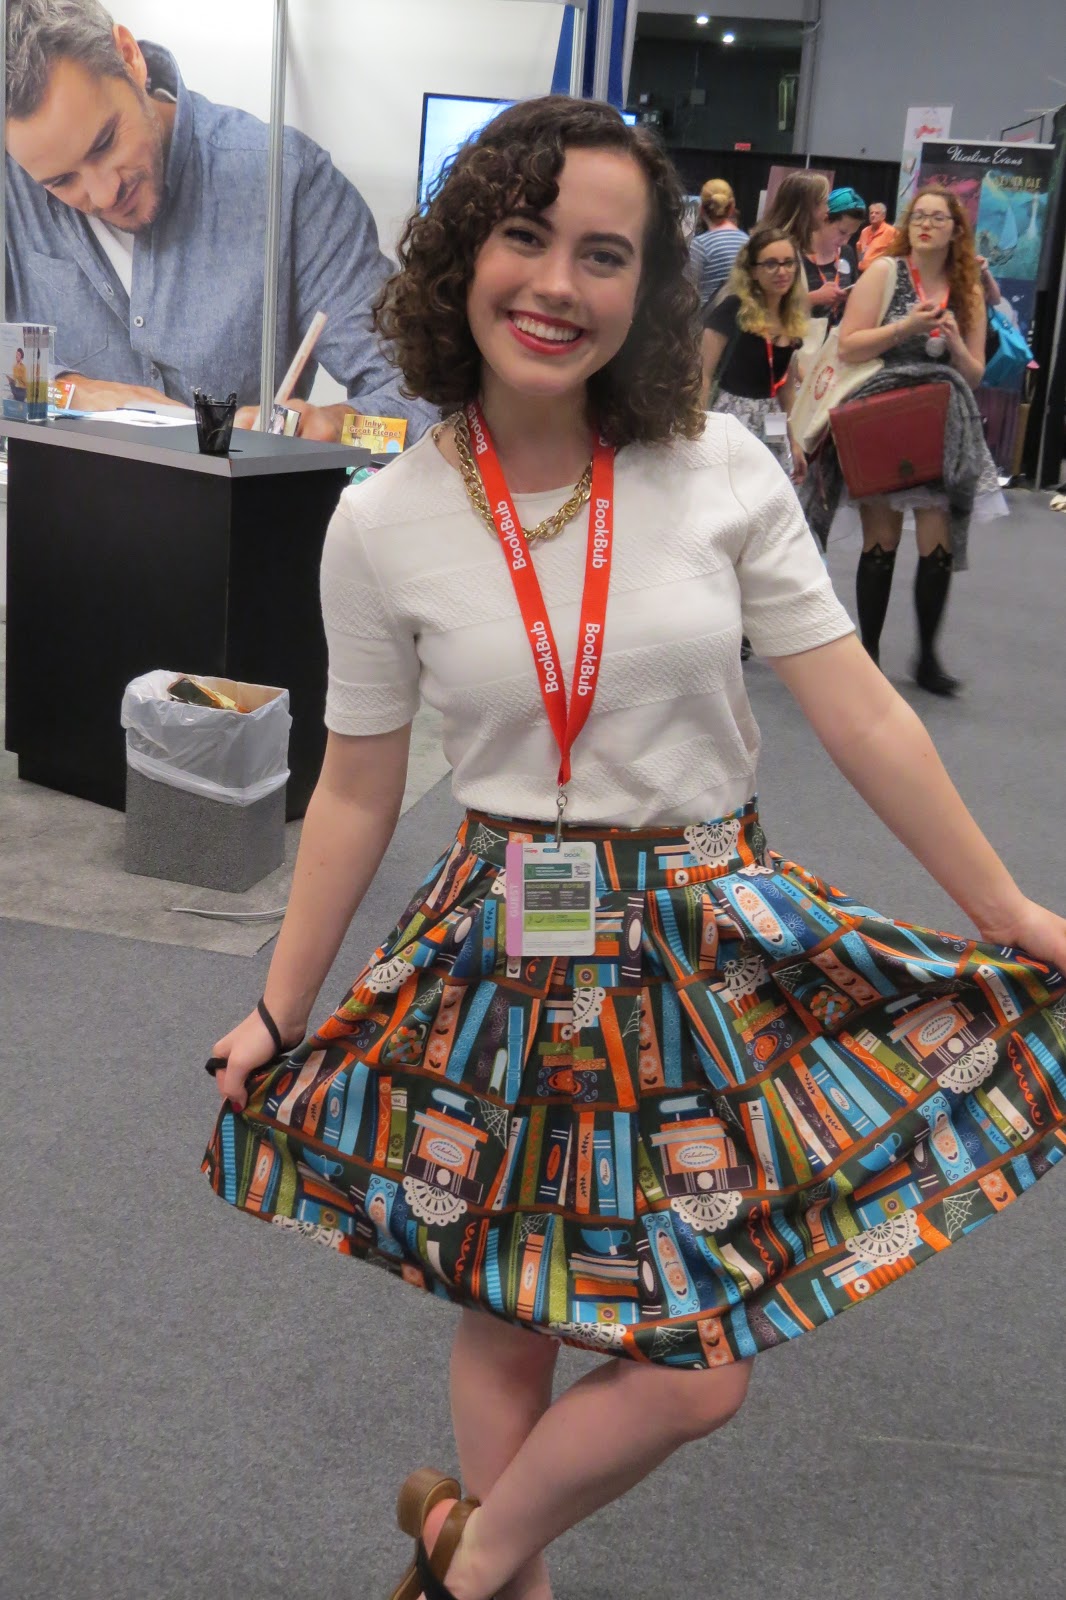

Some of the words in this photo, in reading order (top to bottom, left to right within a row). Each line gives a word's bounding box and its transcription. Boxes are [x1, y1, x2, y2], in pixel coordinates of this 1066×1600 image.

[992, 148, 1024, 166] Evans
[468, 402, 488, 455] BookB
[494, 500, 526, 571] BookBub
[592, 498, 610, 569] BookBub
[530, 620, 559, 694] BookBub
[577, 622, 600, 697] BookBub
